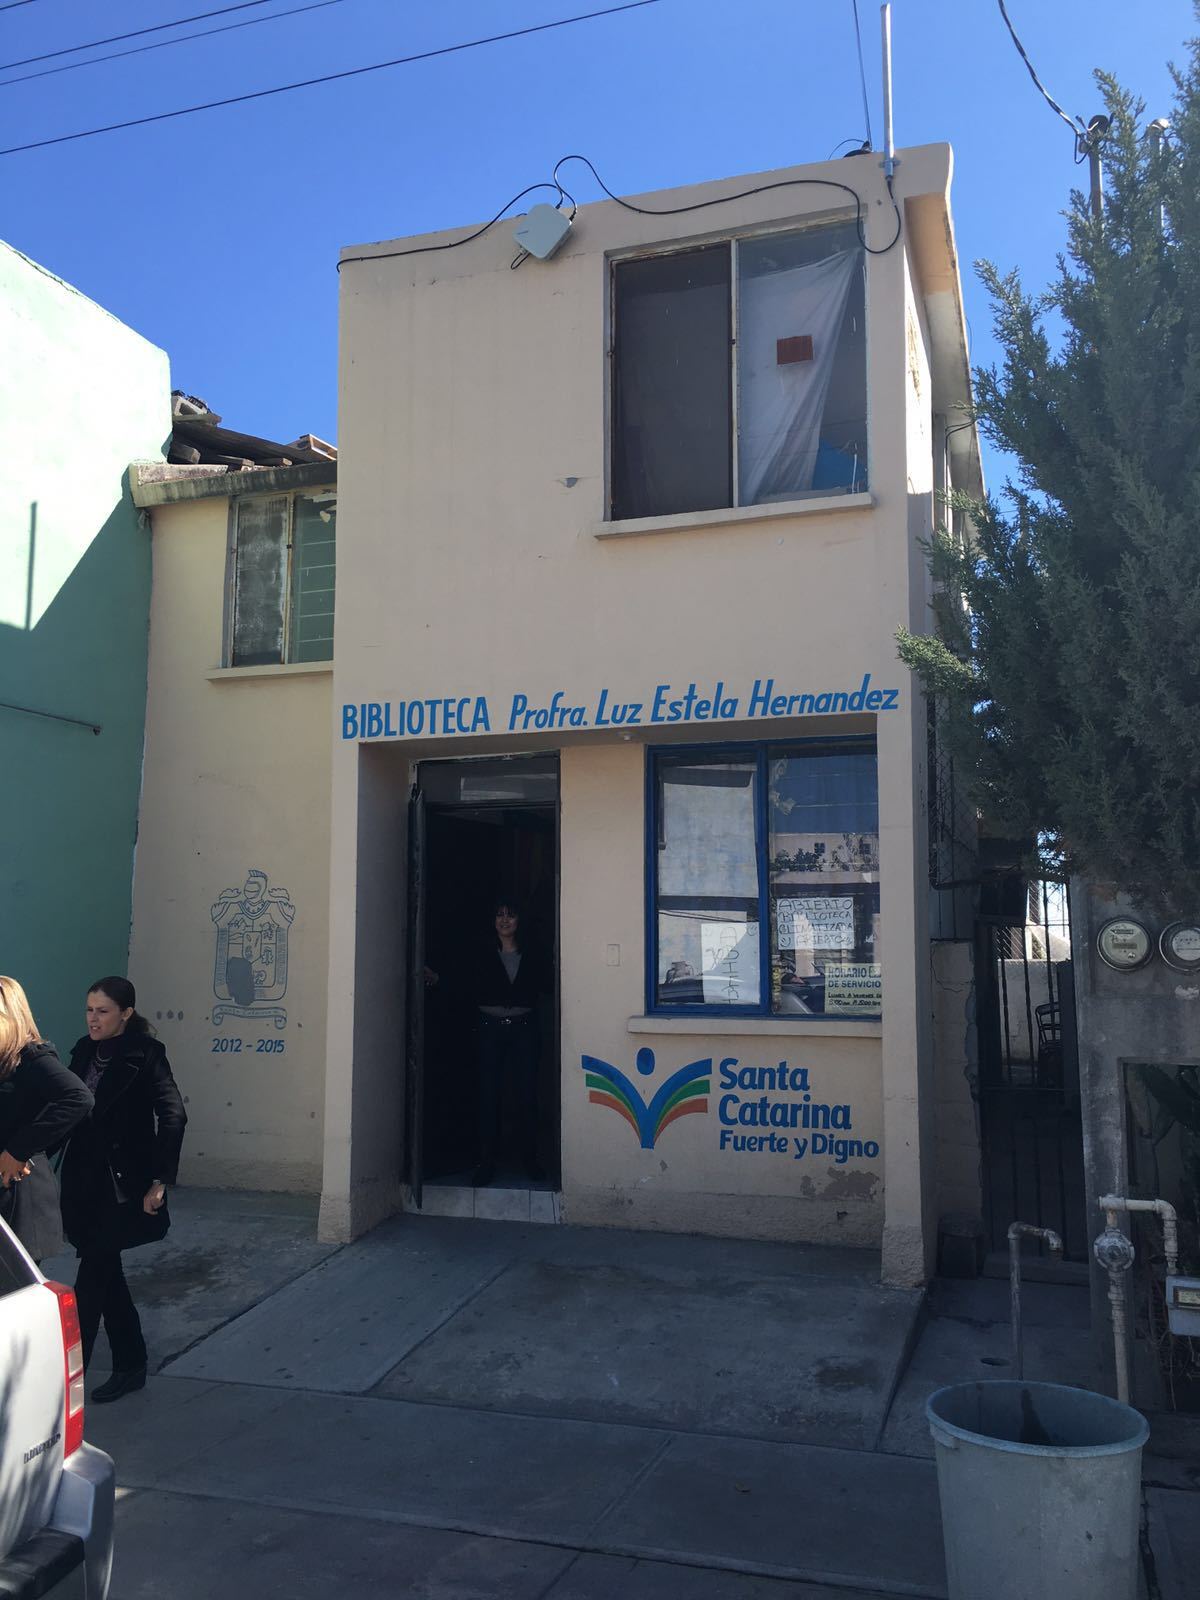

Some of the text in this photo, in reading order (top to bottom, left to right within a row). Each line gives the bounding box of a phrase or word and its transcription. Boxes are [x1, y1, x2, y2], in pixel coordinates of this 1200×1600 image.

[342, 673, 899, 739] BIBLIOTECA Profra. Luz Estela Hernandez
[778, 898, 853, 911] ABIERTO
[828, 967, 867, 978] HORARIO
[828, 980, 881, 988] DE SERVICIO
[211, 1038, 242, 1053] 2012
[256, 1039, 285, 1053] 2015
[719, 1057, 810, 1091] Santa
[718, 1094, 852, 1130] Catarina
[719, 1130, 879, 1163] Fuerte y Digno
